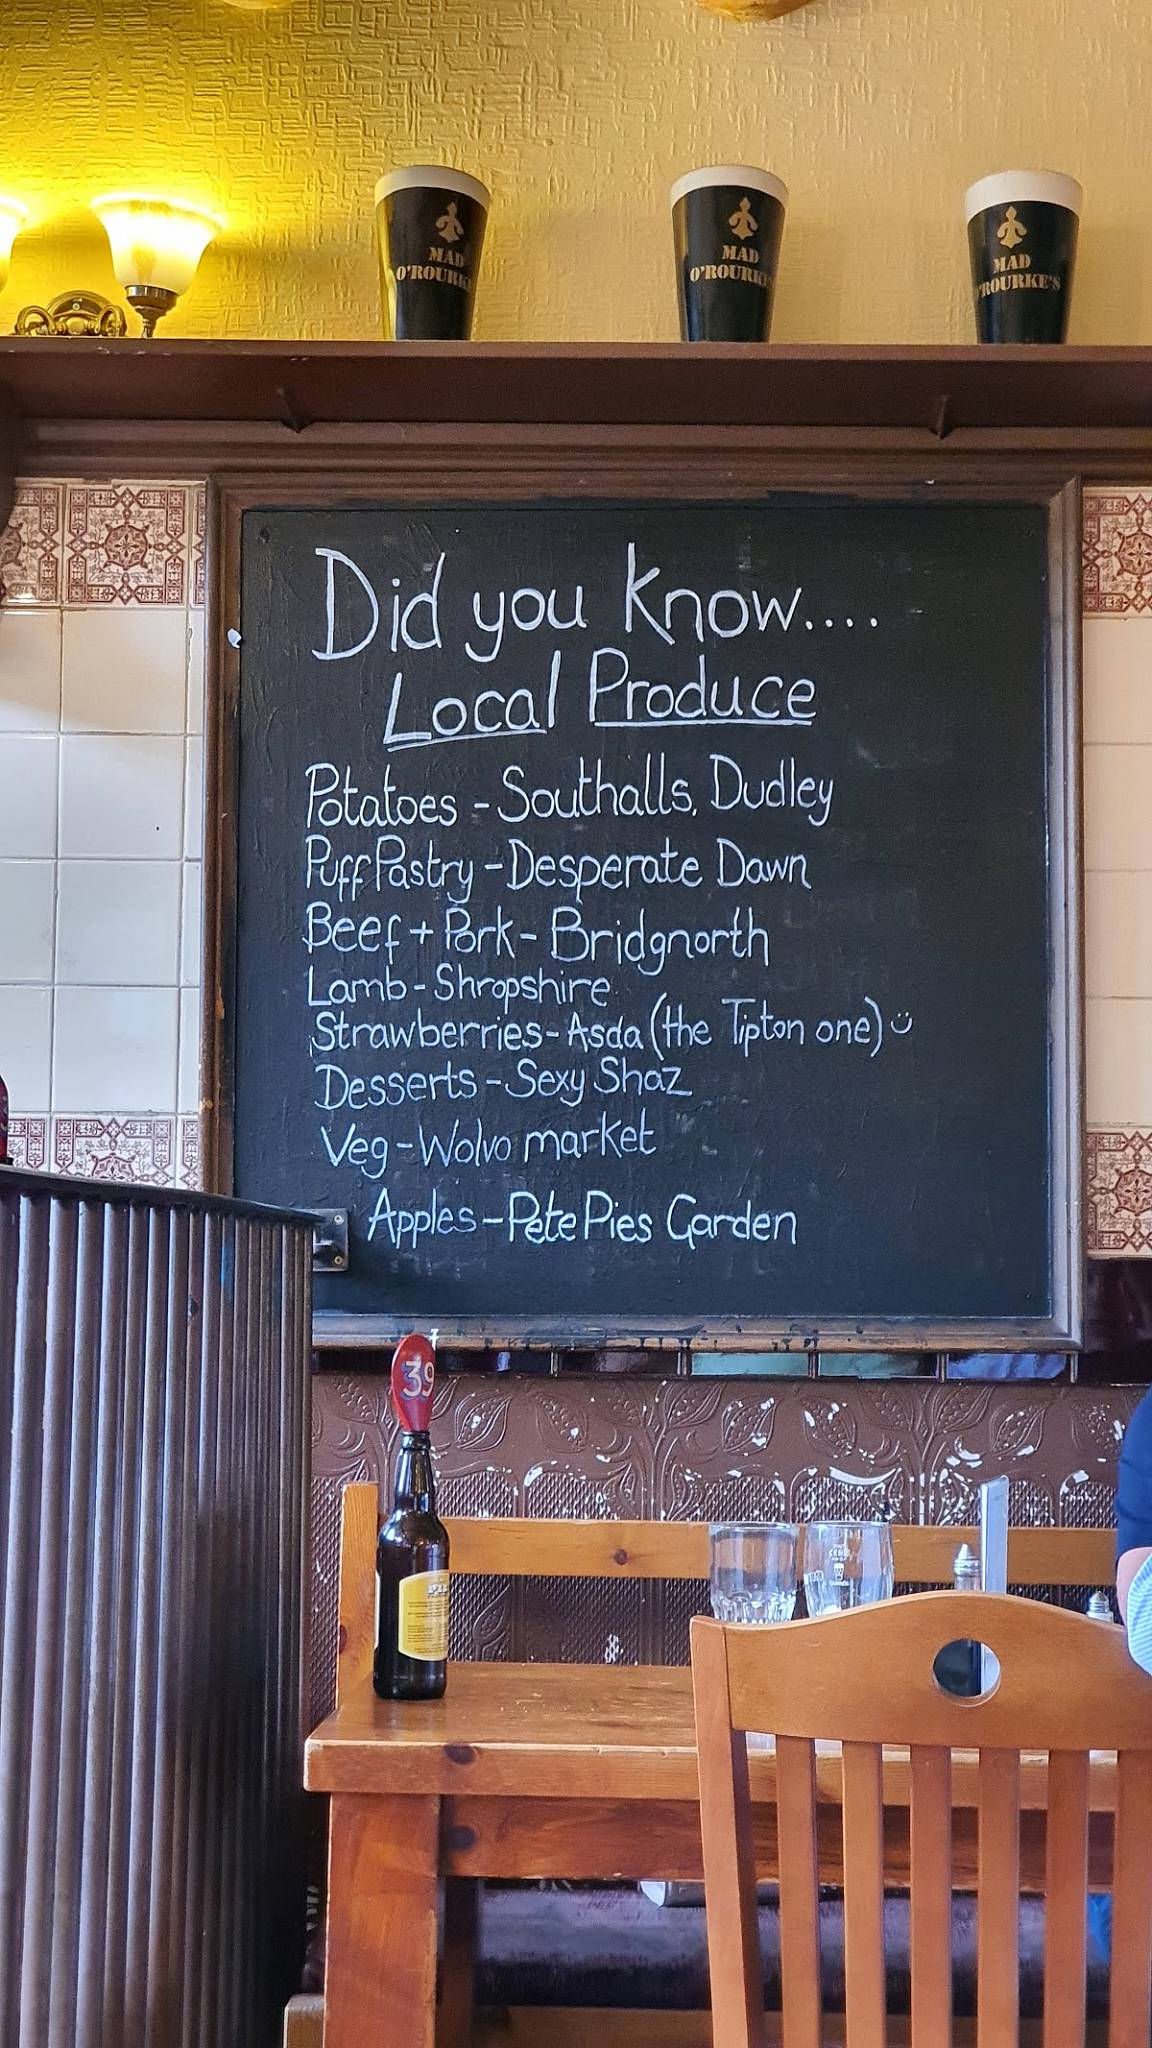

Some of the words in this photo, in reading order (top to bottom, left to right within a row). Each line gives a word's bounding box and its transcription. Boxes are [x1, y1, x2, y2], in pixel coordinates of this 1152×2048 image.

[396, 264, 472, 291] O'ROURK
[428, 246, 464, 268] MAD
[722, 244, 759, 264] MAD
[993, 253, 1031, 274] MAD
[312, 548, 445, 660] Did
[465, 585, 587, 662] you
[383, 650, 561, 744] Local
[589, 647, 817, 723] Produce
[305, 762, 458, 828] Potatoes
[709, 754, 834, 826] Dudley
[305, 834, 371, 902] Puff
[376, 834, 474, 904] Pastry
[507, 837, 703, 905] Desperate
[716, 837, 812, 889] Dawn
[302, 901, 402, 965] Beef
[410, 921, 434, 944] +
[445, 906, 515, 958] Pork
[551, 906, 769, 976] Bridgnorth
[307, 965, 408, 1006] Lamb
[434, 962, 611, 1015] Shropshire
[568, 1011, 644, 1052] Asda
[650, 992, 713, 1061] (the
[721, 998, 805, 1057] Tipton
[815, 996, 883, 1058] one)
[314, 1060, 478, 1110] Desserts
[505, 1058, 585, 1107] Sexy
[593, 1055, 693, 1096] Shaz
[320, 1122, 389, 1179] Veg
[418, 1117, 512, 1168] Wolvo
[367, 1187, 478, 1250] Apples
[508, 1190, 577, 1244] Pete
[584, 1189, 653, 1243] Pies
[666, 1193, 797, 1250] Garden
[402, 1360, 435, 1398] 39
